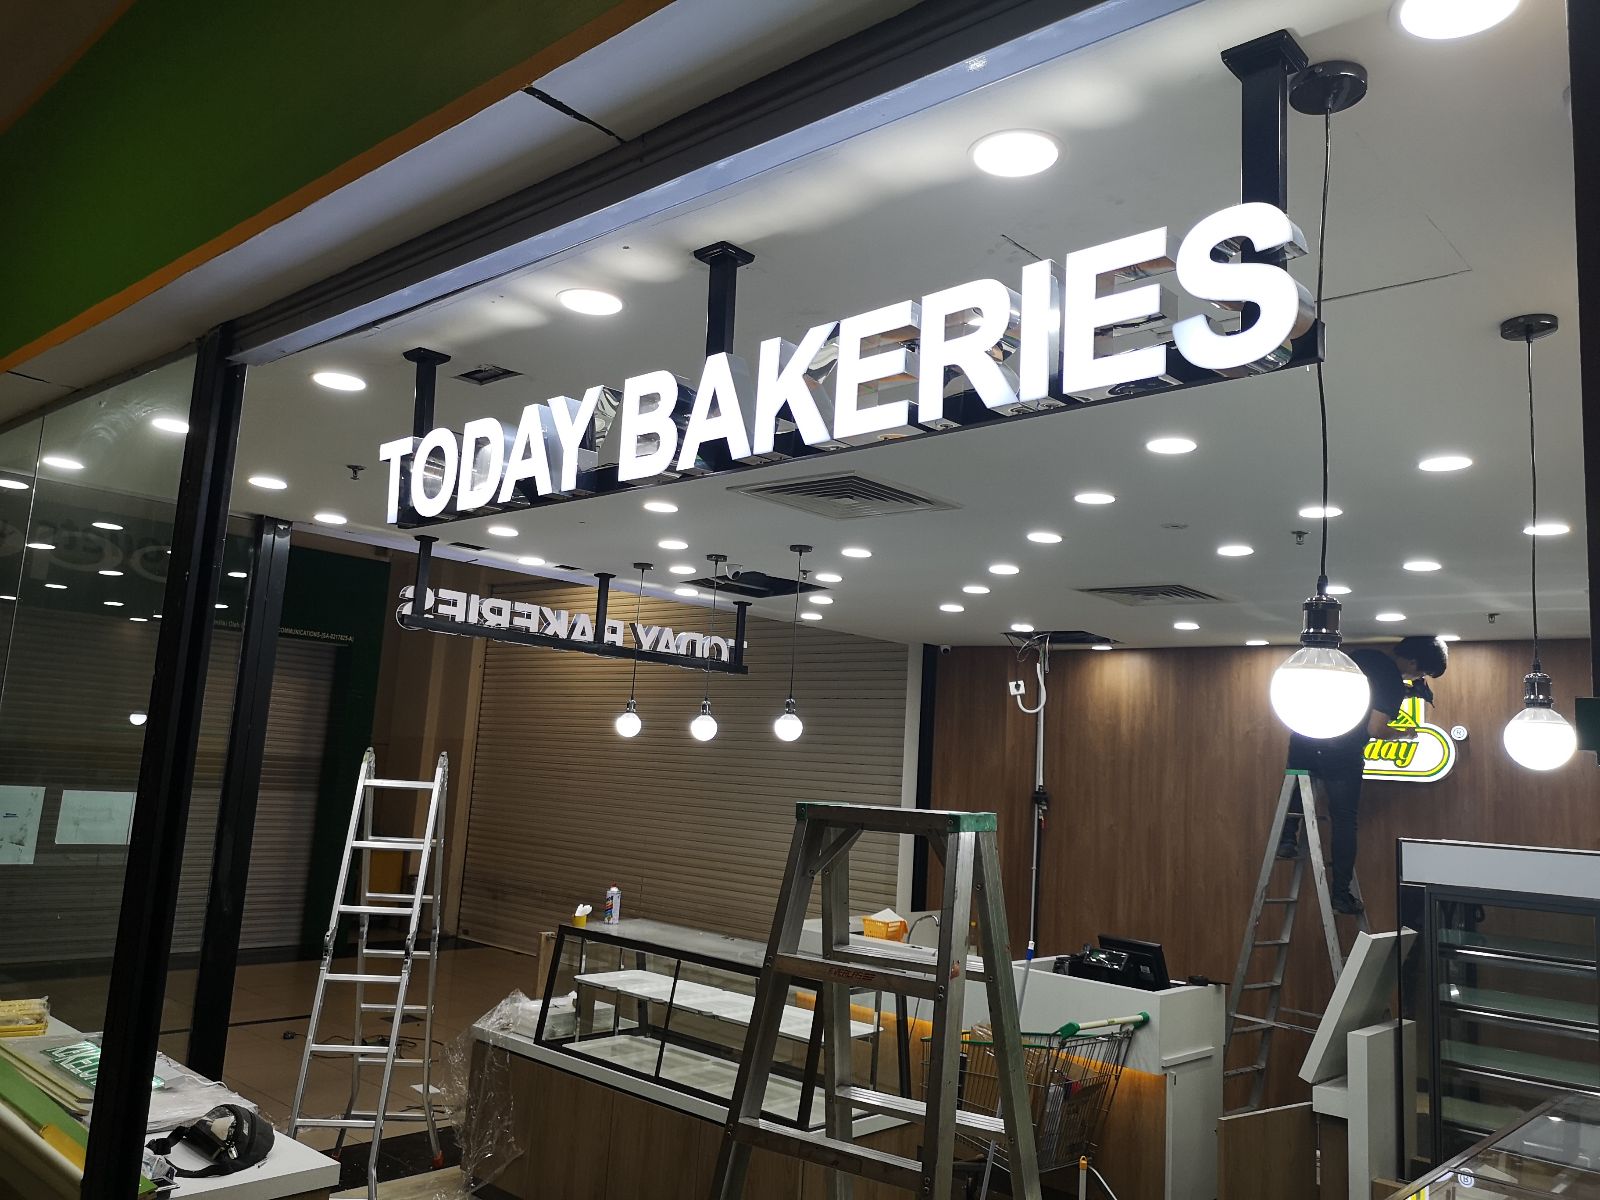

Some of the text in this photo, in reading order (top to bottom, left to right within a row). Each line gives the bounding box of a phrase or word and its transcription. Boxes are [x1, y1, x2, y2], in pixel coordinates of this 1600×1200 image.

[380, 202, 1300, 524] TODAY BAKERIES
[1363, 738, 1420, 768] day
